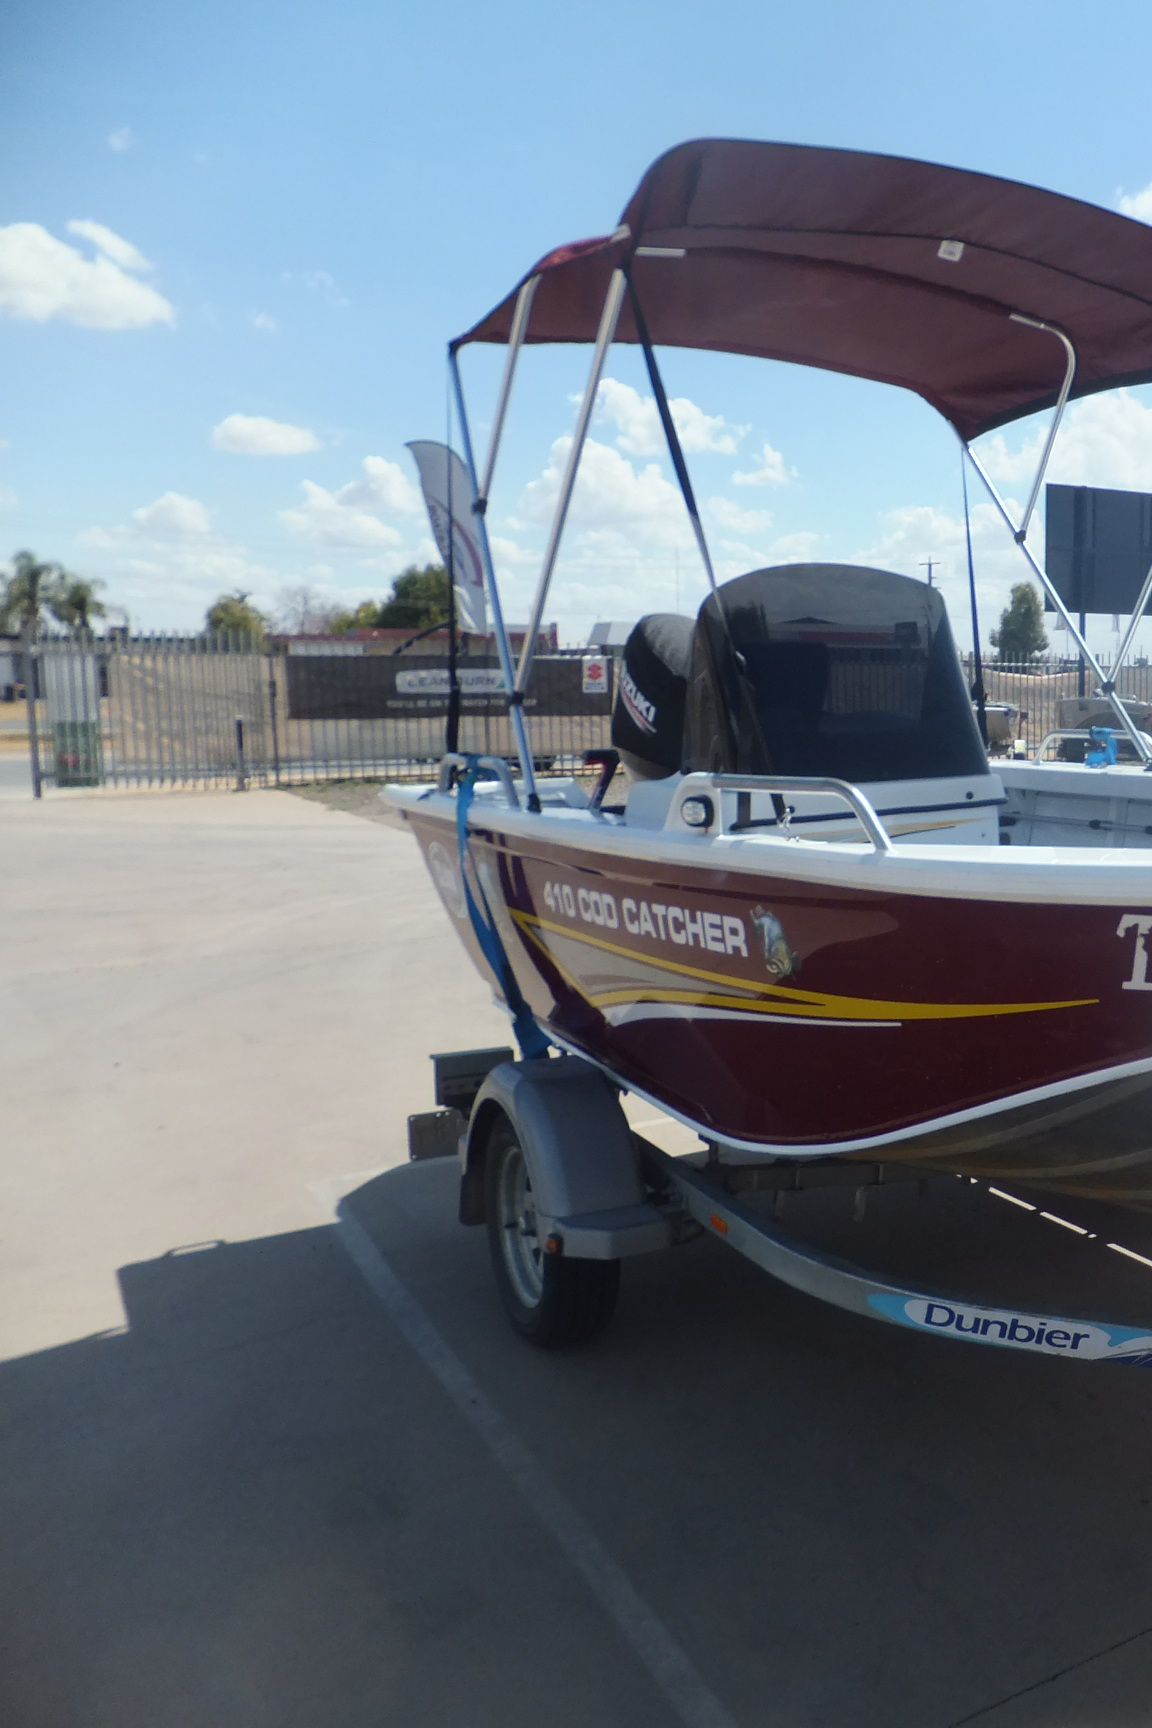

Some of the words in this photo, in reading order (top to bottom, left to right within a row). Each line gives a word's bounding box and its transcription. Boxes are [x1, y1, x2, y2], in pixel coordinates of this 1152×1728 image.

[407, 675, 496, 688] LEANURN
[543, 880, 577, 919] 410
[577, 887, 620, 930] COD
[621, 897, 749, 958] CATCHER
[923, 1302, 1091, 1351] Dunbier
